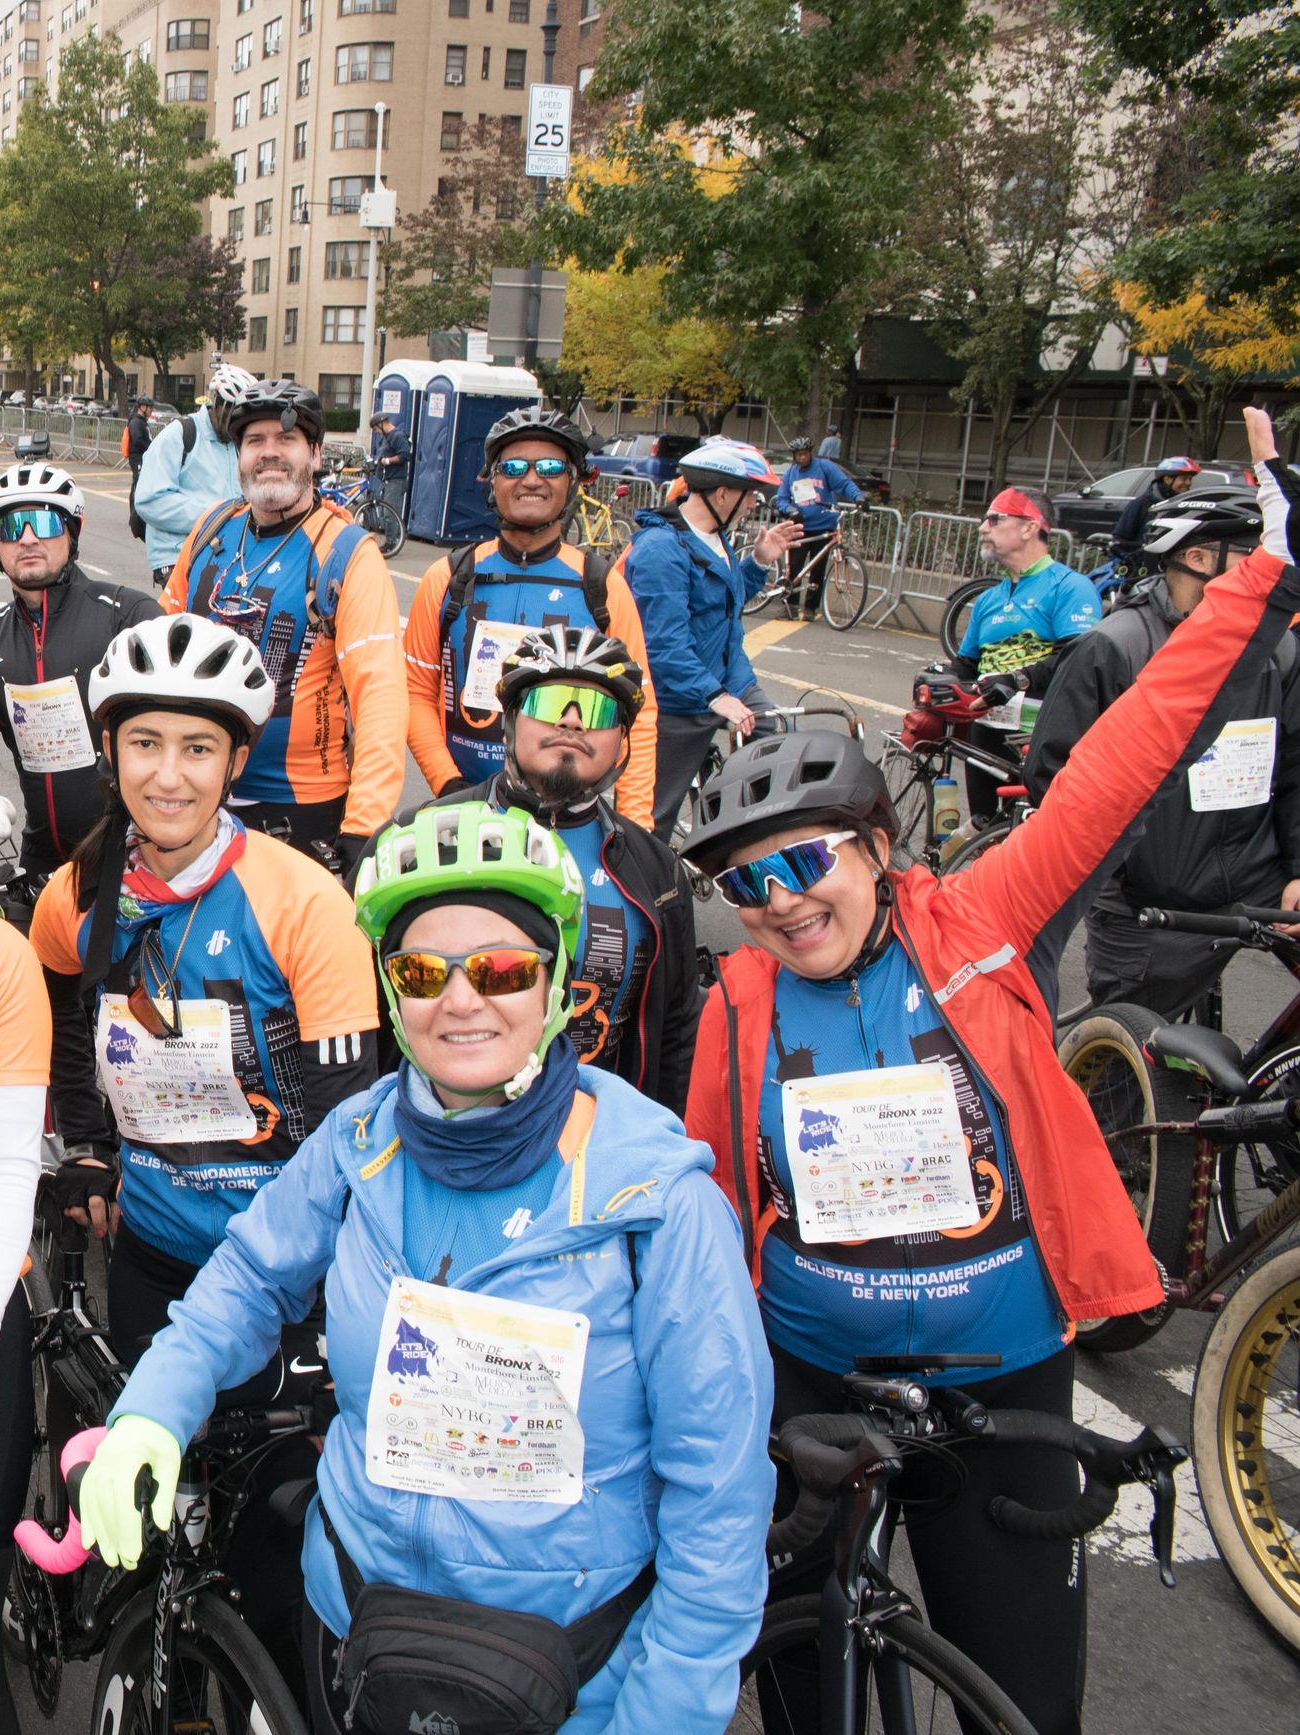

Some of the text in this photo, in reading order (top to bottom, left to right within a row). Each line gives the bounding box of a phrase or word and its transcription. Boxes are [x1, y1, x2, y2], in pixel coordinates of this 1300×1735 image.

[543, 90, 560, 98] CITY
[539, 101, 562, 109] SPEED
[534, 123, 564, 147] 25
[531, 164, 564, 173] ENFORCED
[1188, 501, 1216, 509] GIRO
[452, 736, 485, 751] CICLISTAS
[478, 751, 489, 760] DE
[164, 1041, 197, 1049] BRONX
[146, 1080, 181, 1090] NYBG
[852, 1103, 892, 1114] TOUR DE
[878, 1108, 944, 1120] BRONX 2022
[852, 1160, 895, 1174] NYBG
[922, 1155, 952, 1167] BRAC
[172, 1176, 187, 1187] DE
[218, 1179, 259, 1190] YORK
[794, 1245, 1024, 1287] CICLISTAS LATINOAMERICANOS
[852, 1280, 970, 1301] DE NEW YORK
[396, 1342, 424, 1351] LET'S
[455, 1336, 505, 1357] TOUR DE
[484, 1354, 534, 1372] BRONX
[464, 1362, 551, 1383] Montefiore Einste
[440, 1402, 492, 1426] NYBG
[527, 1418, 564, 1431] BRAC
